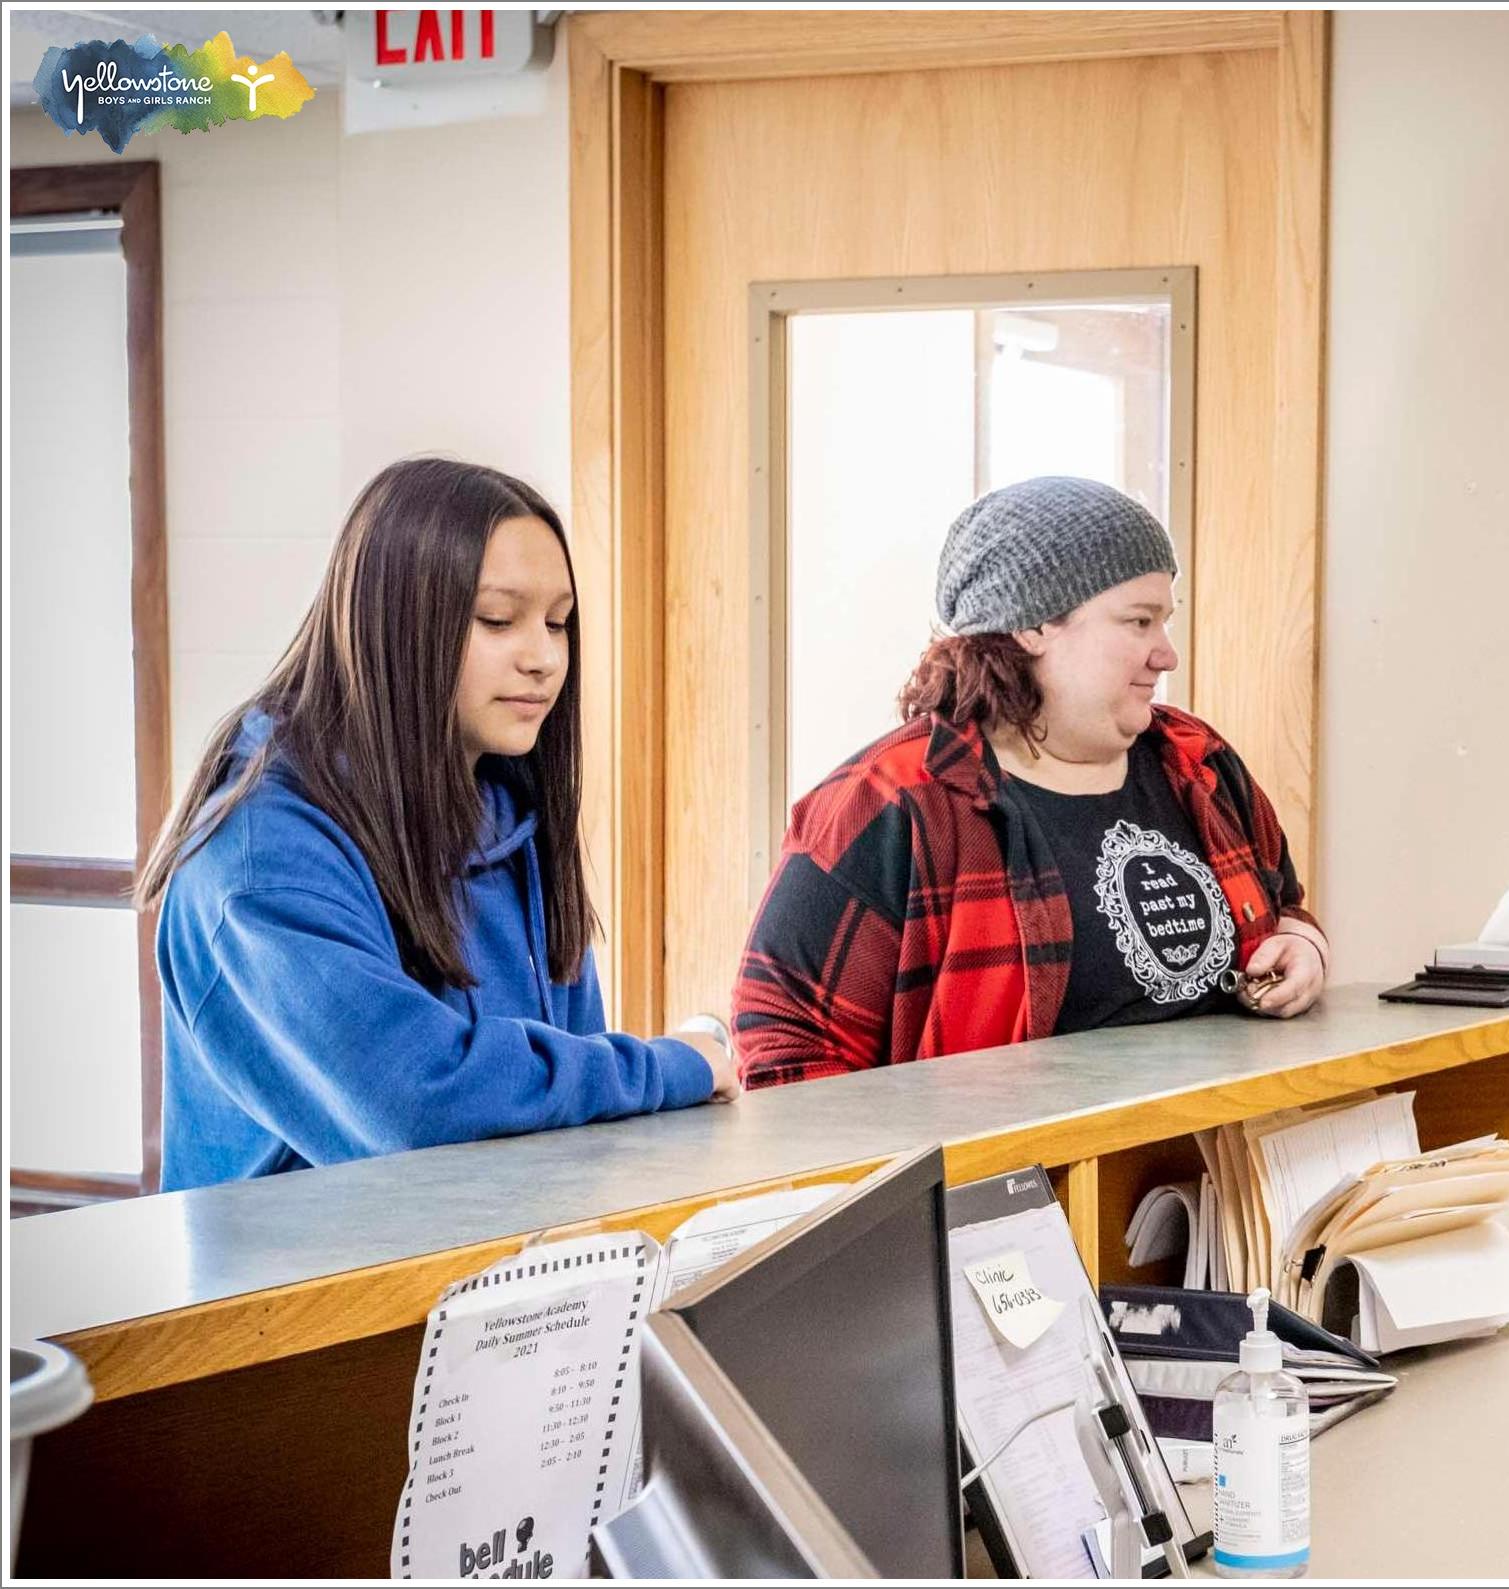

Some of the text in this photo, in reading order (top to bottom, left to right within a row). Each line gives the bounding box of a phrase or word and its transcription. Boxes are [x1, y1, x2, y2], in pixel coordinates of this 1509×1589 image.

[1141, 862, 1156, 875] I
[1140, 873, 1178, 891] read
[1140, 893, 1196, 916] past my
[1146, 917, 1206, 938] bedtime
[484, 1299, 589, 1333] Yellowstone Academy
[475, 1314, 592, 1352] Daily Summer Schedule
[513, 1341, 539, 1359] 2021
[438, 1395, 460, 1409] Check
[434, 1413, 455, 1428] Block
[432, 1432, 452, 1447] Block
[428, 1443, 475, 1465] Lunch Break
[426, 1471, 448, 1485] Block
[425, 1485, 462, 1504] Check Out
[460, 1528, 507, 1578] bell
